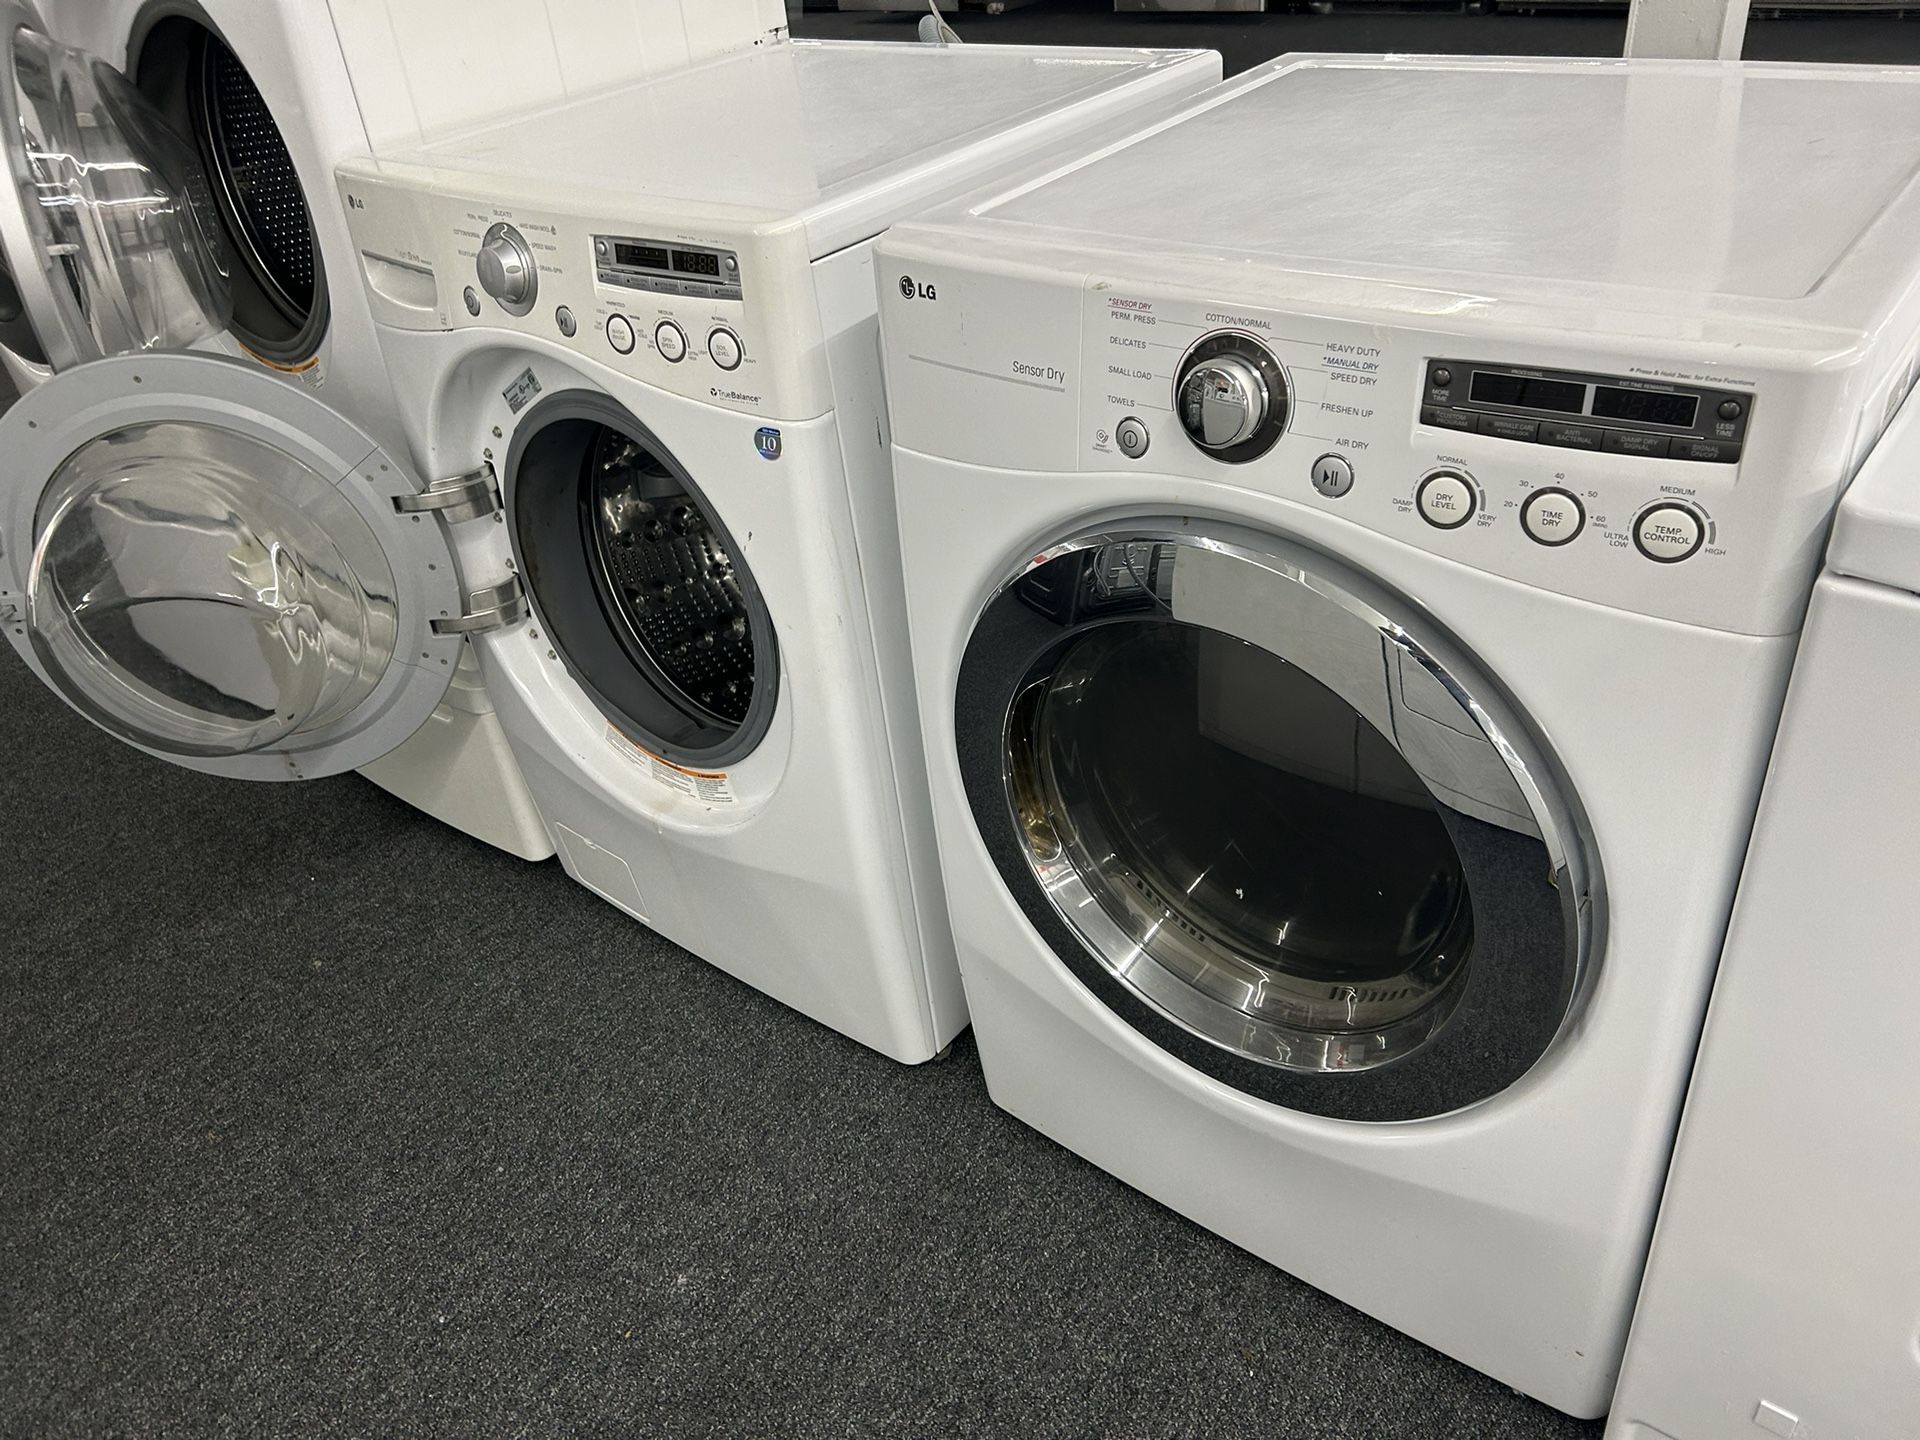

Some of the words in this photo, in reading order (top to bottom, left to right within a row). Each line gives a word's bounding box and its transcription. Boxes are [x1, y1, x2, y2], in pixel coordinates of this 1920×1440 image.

[918, 282, 937, 300] LG
[1138, 302, 1152, 311] DRY
[1111, 311, 1132, 321] PERM.
[1133, 314, 1156, 325] PRESS
[1205, 312, 1272, 330] COTTON/NORMAL
[1109, 335, 1147, 349] DELICATES
[1326, 342, 1355, 354] HEAVY
[1356, 346, 1381, 358] DUTY
[1362, 361, 1380, 371] DRY
[1012, 360, 1045, 378] Sensor
[1047, 367, 1065, 384] Dry
[1108, 365, 1132, 377] SMALL
[1132, 370, 1152, 381] LOAD
[1330, 371, 1358, 384] SPEED
[1359, 376, 1378, 386] DRY
[1432, 388, 1450, 396] MORE
[1107, 395, 1135, 407] TOWELS
[1321, 402, 1360, 416] FRESHEN
[1361, 409, 1374, 418] UP
[1715, 422, 1735, 430] LESS
[1715, 429, 1733, 437] TIME
[761, 435, 777, 451] 10
[1335, 438, 1350, 447] AIR
[1351, 440, 1369, 450] DRY
[1555, 434, 1592, 445] BACTERIAL
[1620, 435, 1642, 444] DAMP
[1643, 438, 1659, 446] DRY
[1436, 454, 1468, 466] NORMAL
[1554, 472, 1565, 481] 40
[1518, 479, 1529, 488] 30
[1587, 490, 1598, 498] 50
[1660, 485, 1697, 497] MEDIUM
[1435, 492, 1454, 501] DRY
[1392, 497, 1414, 507] DAMP
[1430, 501, 1457, 511] LEVEL
[1503, 500, 1513, 508] 20
[1397, 505, 1413, 514] DRY
[1478, 513, 1497, 522] VERY
[1541, 510, 1564, 520] TIME
[1595, 515, 1607, 523] 60
[1477, 520, 1493, 528] DRY
[1541, 518, 1561, 528] DRY
[1654, 525, 1683, 536] TEMP.
[1603, 531, 1630, 542] ULTRA
[1643, 532, 1692, 546] CONTROL
[1609, 539, 1629, 549] LOW
[1704, 547, 1727, 557] HIGH
